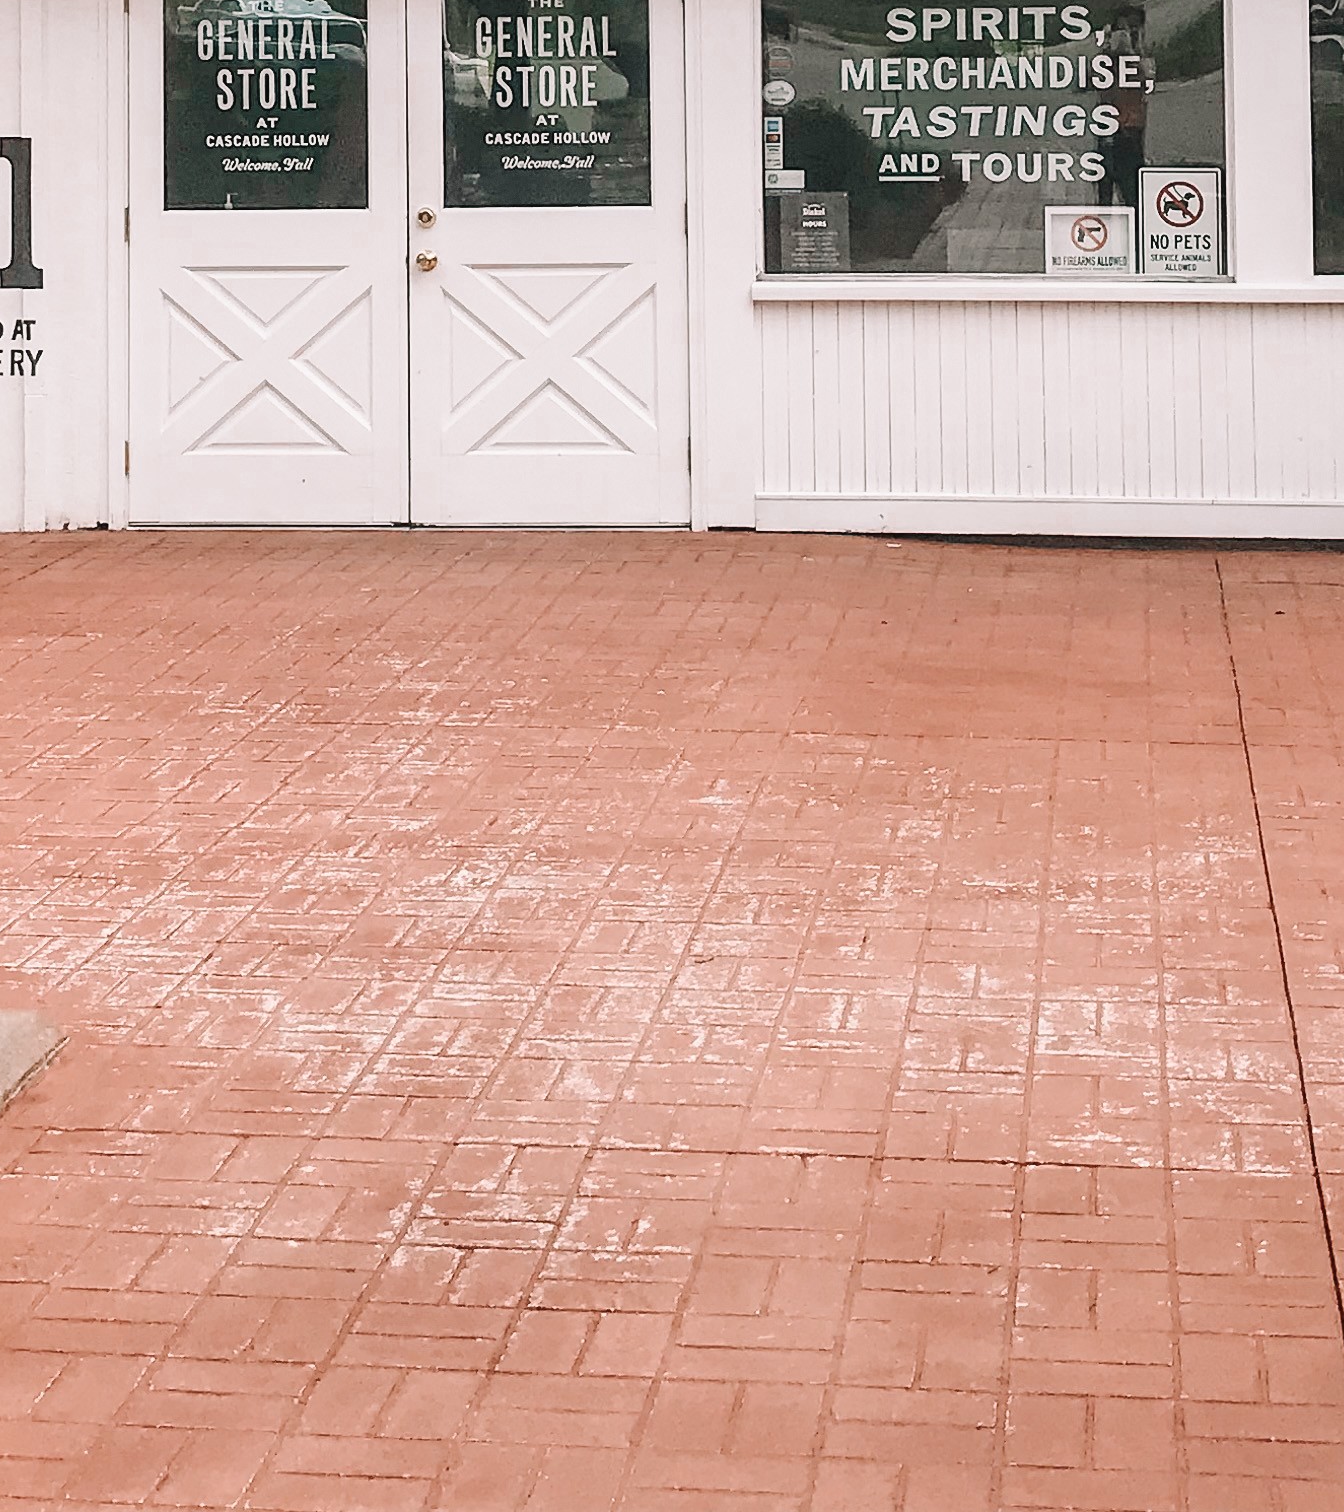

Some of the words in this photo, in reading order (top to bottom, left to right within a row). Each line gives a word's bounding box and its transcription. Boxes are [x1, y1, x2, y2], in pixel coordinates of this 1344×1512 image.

[197, 17, 336, 62] GENERAL
[475, 15, 618, 60] GENERAL
[885, 5, 1111, 48] SPIRITS,
[216, 67, 318, 111] STORE
[495, 65, 599, 109] STORE
[840, 55, 1156, 95] MERCHANDISE,
[256, 117, 279, 129] AT
[535, 114, 559, 127] AT
[862, 105, 1121, 138] TASTINGS
[205, 135, 270, 148] CASCADE
[273, 133, 330, 147] HOLLOW
[485, 132, 550, 146] CASCADE
[553, 131, 612, 145] HOLLOW
[879, 154, 942, 178] AND
[951, 152, 1107, 183] TOURS
[1150, 234, 1170, 250] NO
[1174, 234, 1212, 250] PETS
[11, 319, 37, 341] AT
